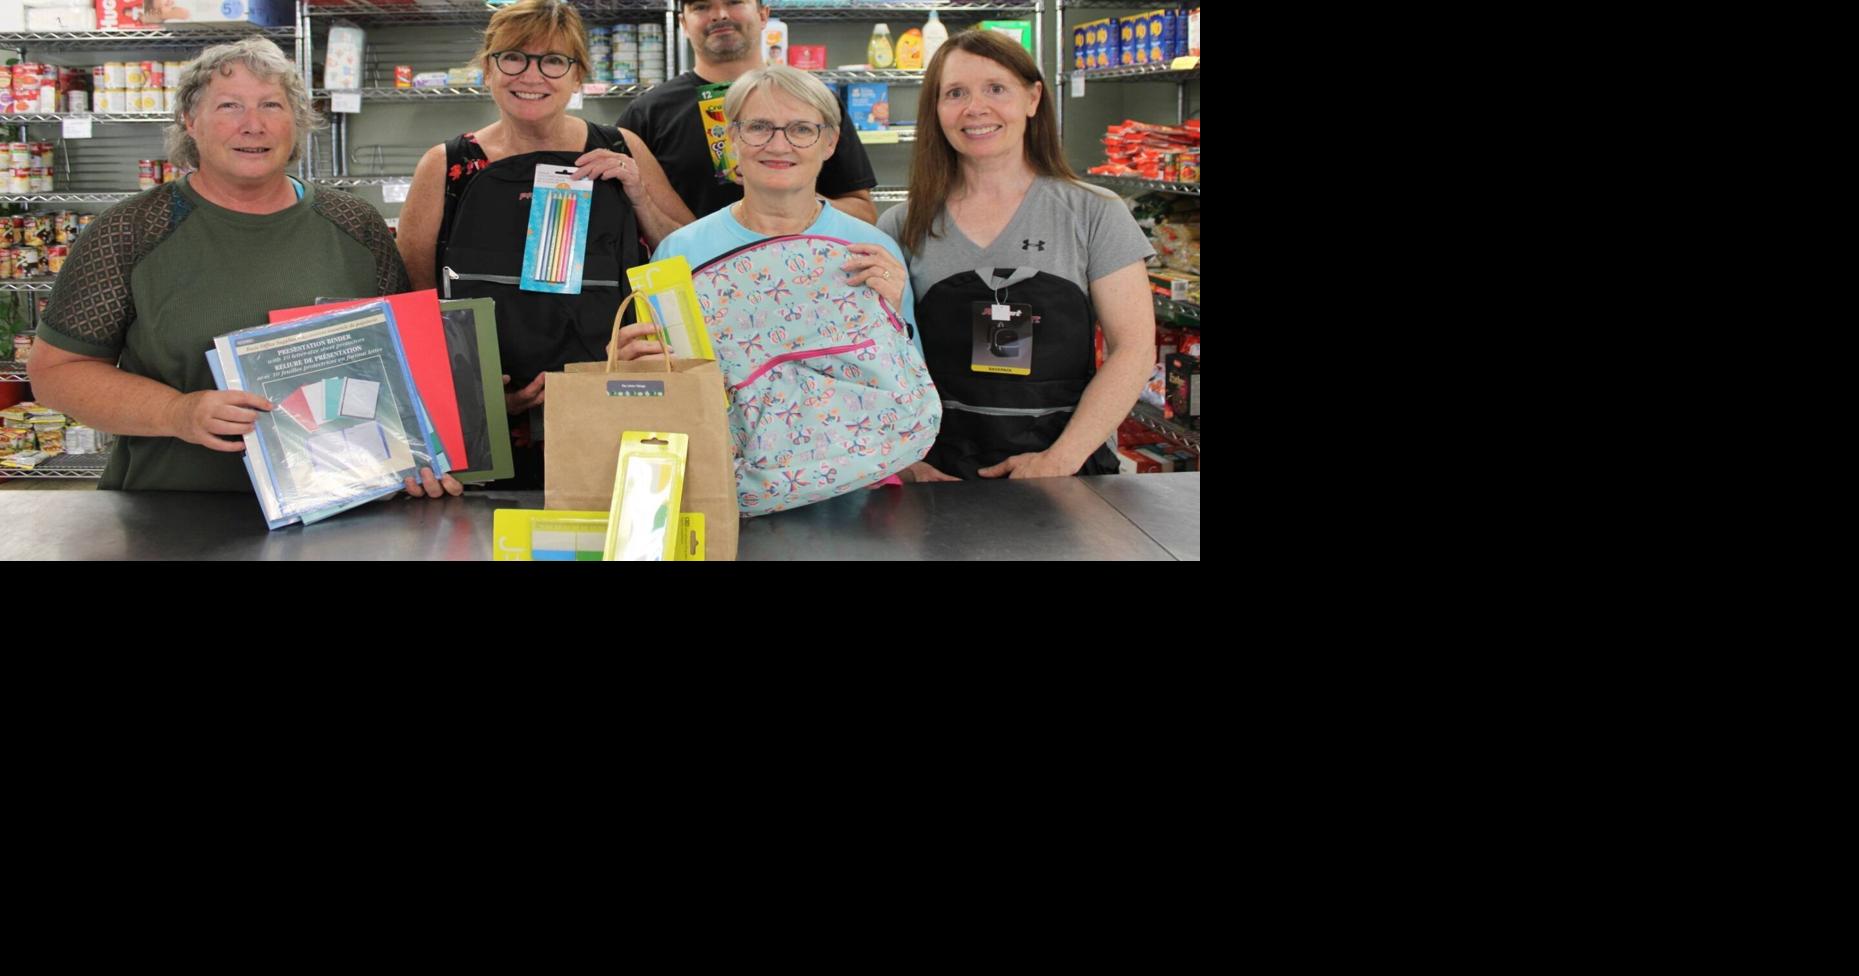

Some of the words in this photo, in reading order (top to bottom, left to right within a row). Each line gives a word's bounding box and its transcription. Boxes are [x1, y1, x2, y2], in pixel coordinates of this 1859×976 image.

[702, 91, 713, 99] 12
[277, 341, 326, 356] PRESENTATION
[327, 334, 352, 345] BINDER
